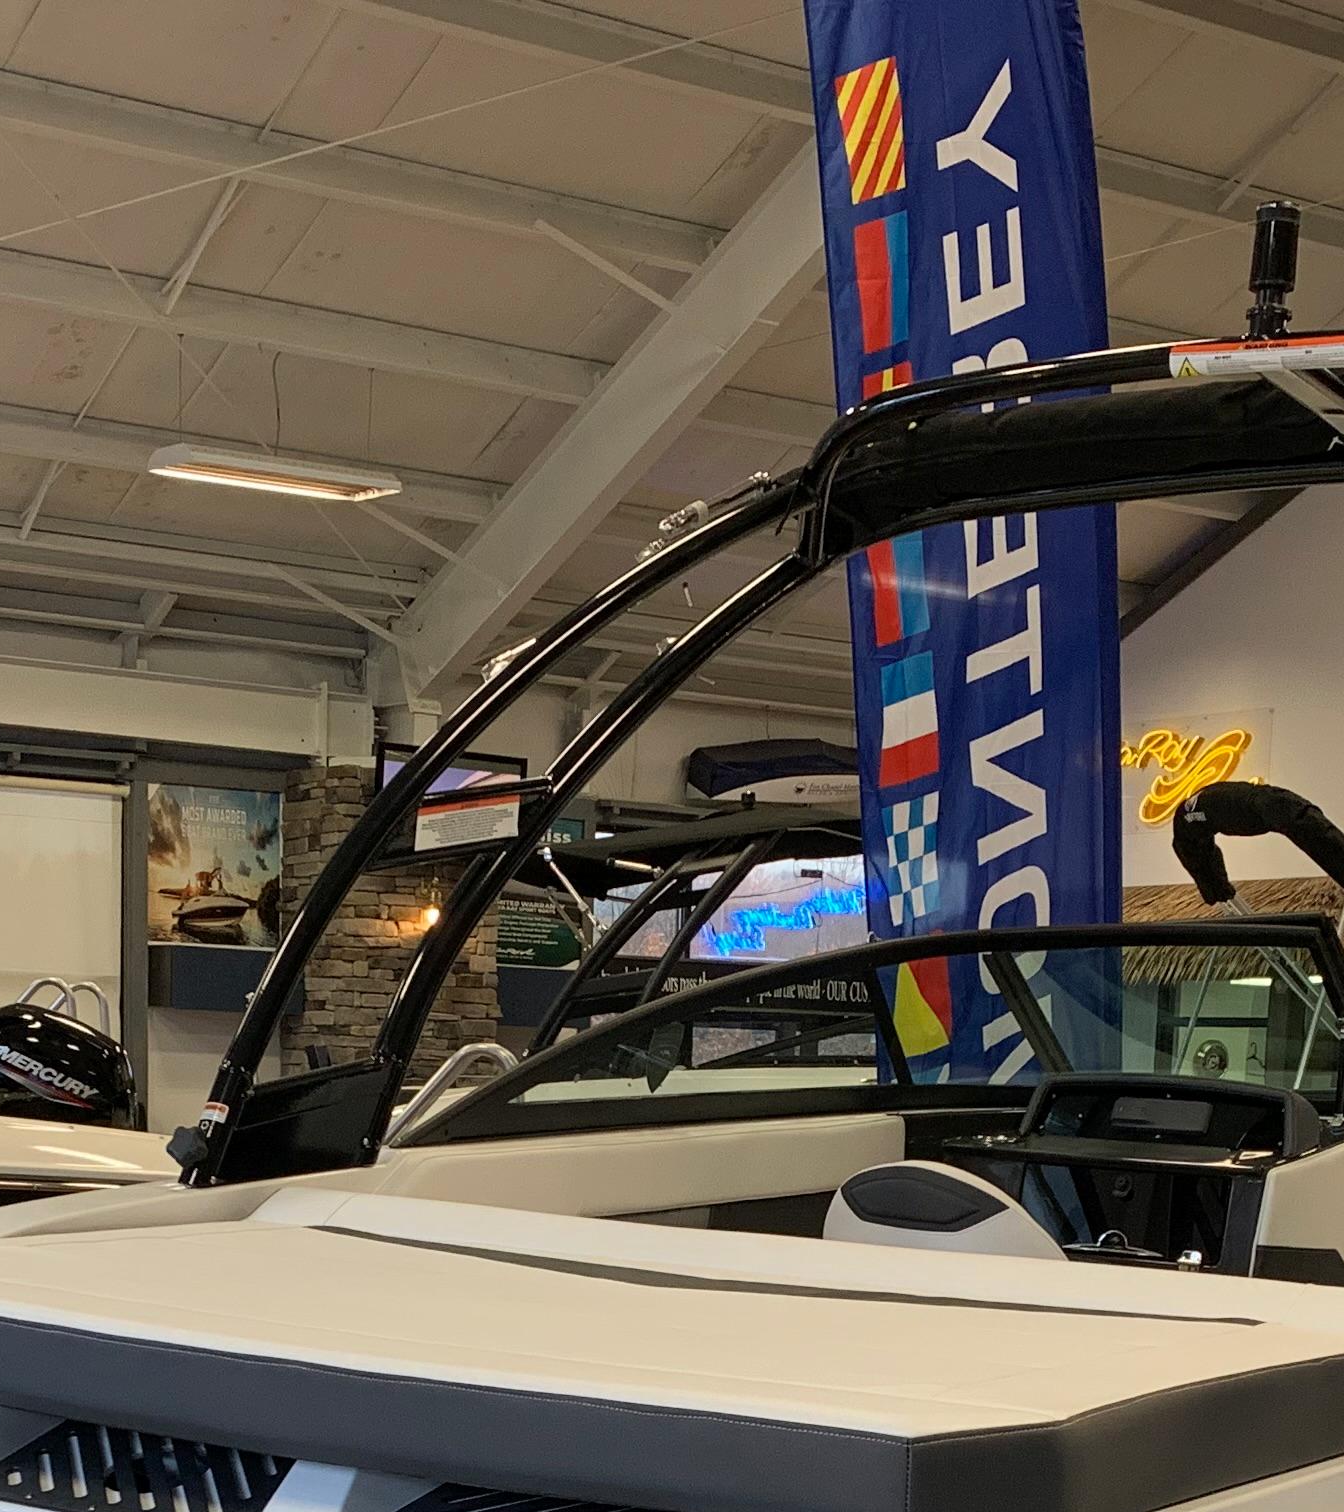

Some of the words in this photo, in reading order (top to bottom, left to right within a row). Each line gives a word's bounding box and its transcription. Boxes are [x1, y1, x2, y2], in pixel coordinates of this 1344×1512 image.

[1136, 729, 1200, 772] Ray
[182, 806, 204, 821] MOST
[207, 807, 247, 825] AWARDED
[797, 978, 820, 999] world
[826, 980, 848, 1001] OUR
